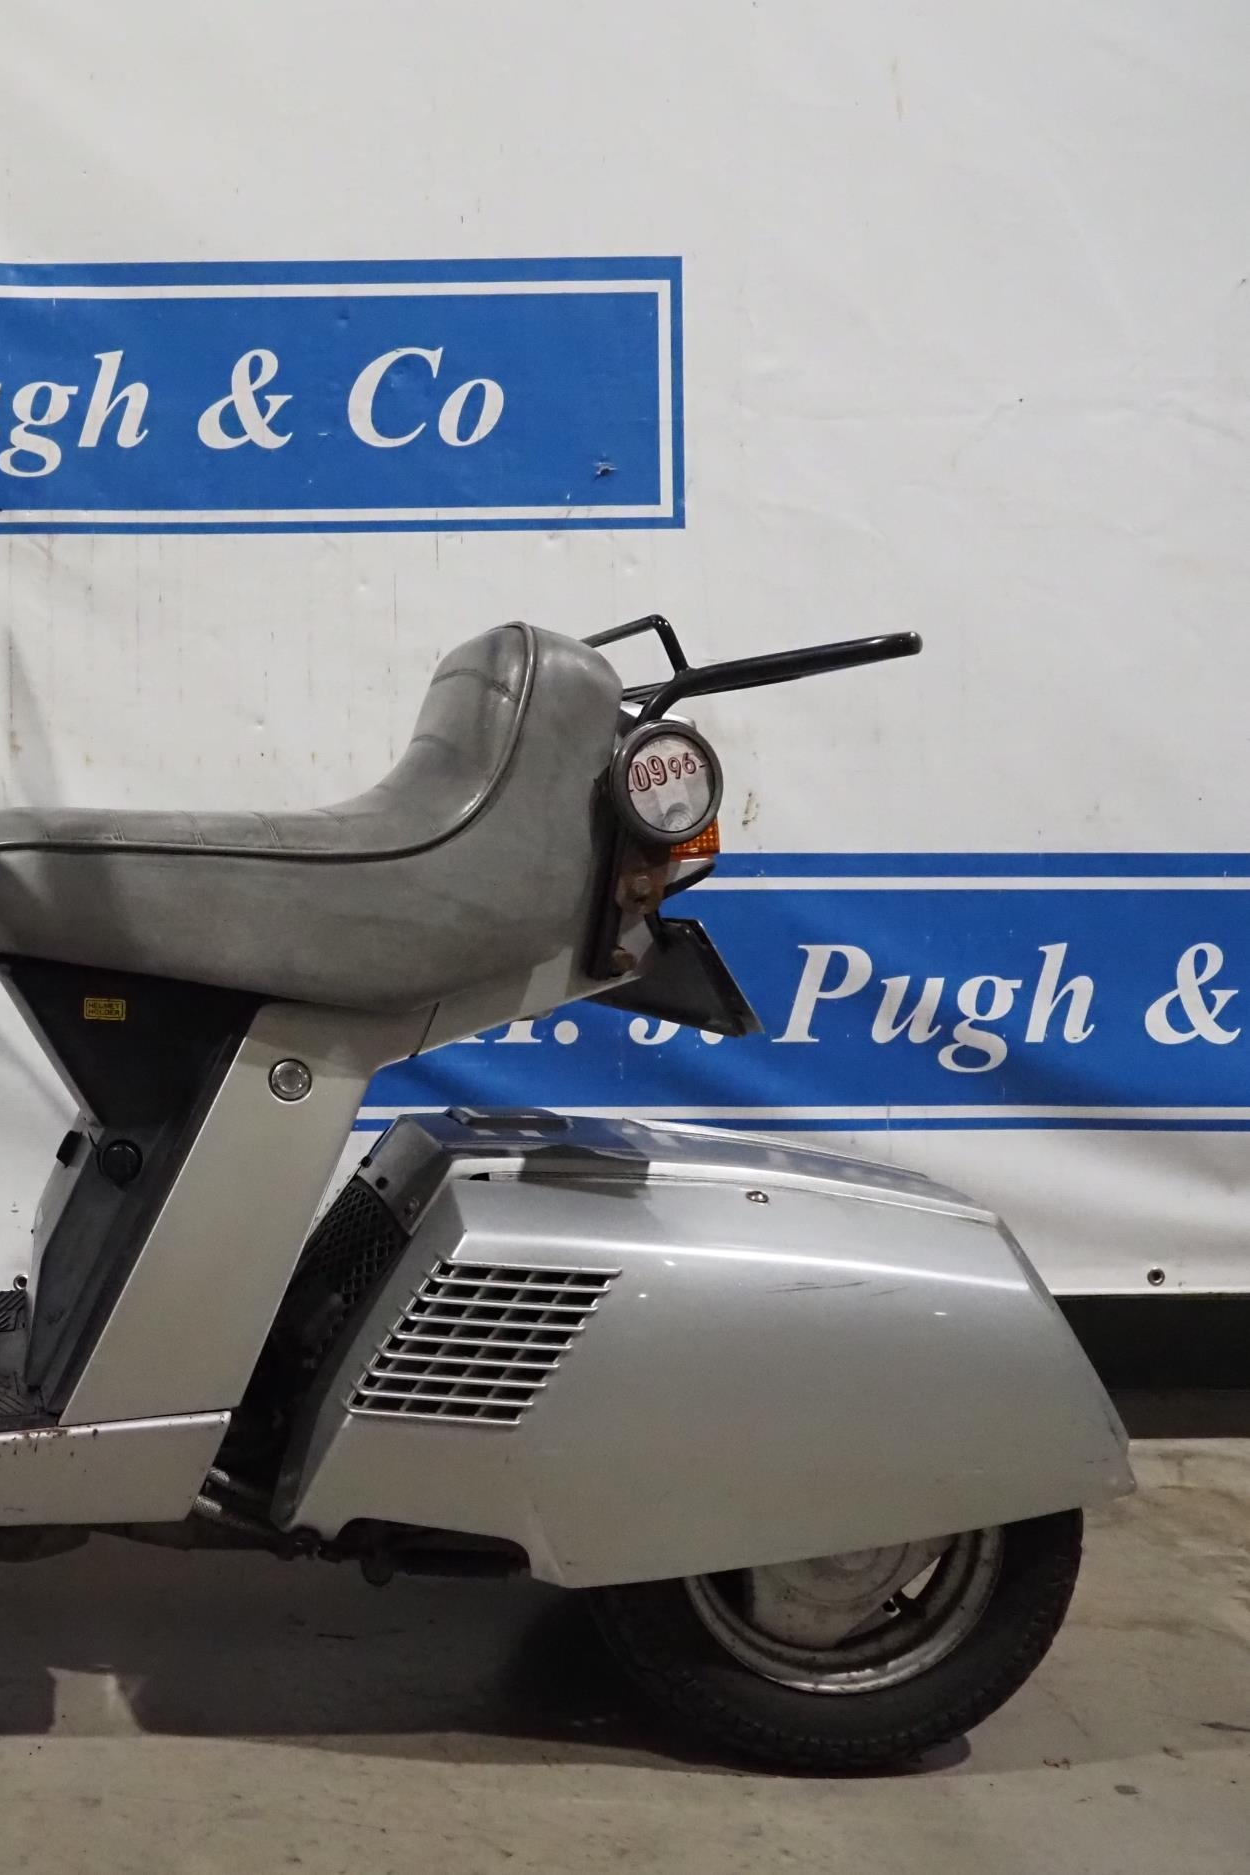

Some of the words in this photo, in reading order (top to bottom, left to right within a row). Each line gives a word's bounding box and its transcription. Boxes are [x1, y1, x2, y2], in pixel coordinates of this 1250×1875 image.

[197, 348, 293, 450] &
[347, 347, 505, 448] Co
[772, 942, 1095, 1073] Pugh
[1144, 942, 1242, 1045] &
